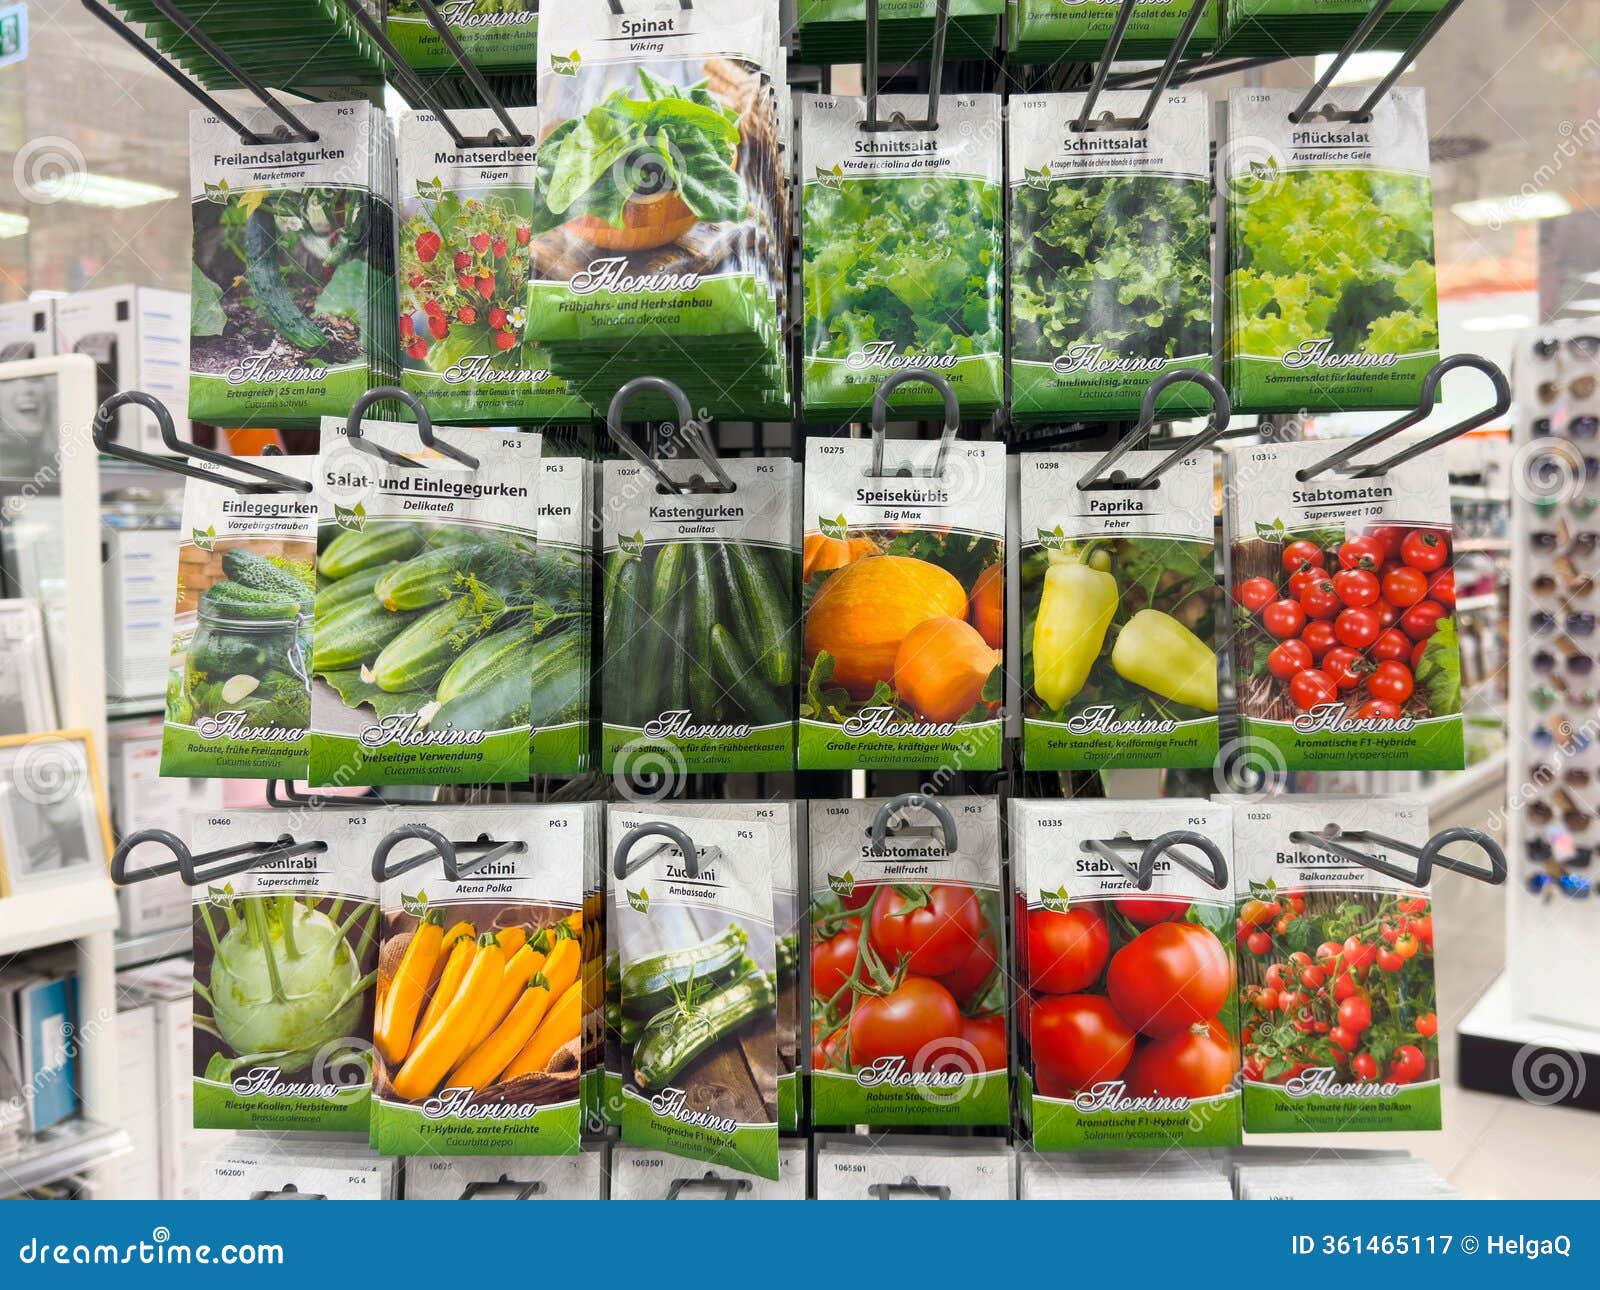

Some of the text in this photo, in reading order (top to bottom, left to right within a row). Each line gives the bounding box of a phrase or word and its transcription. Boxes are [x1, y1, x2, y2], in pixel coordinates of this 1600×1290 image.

[426, 0, 533, 30] Florina
[1069, 10, 1087, 19] und
[1088, 10, 1113, 19] letzte
[621, 18, 675, 37] Spinat
[629, 41, 665, 53] Viking
[1168, 96, 1187, 104] PG 2
[337, 108, 349, 116] PG
[1063, 136, 1149, 151] Schnittsalat
[1292, 131, 1370, 144] Pflücksalat
[854, 140, 939, 153] Schnittsalat
[213, 148, 345, 166] Freilandsalatgurken
[1292, 151, 1372, 161] Australische Gele
[843, 158, 951, 170] Verde ricciolina da taglio
[252, 170, 306, 182] Marketmore
[480, 170, 509, 181] Rügen
[568, 256, 703, 296] Florina
[558, 297, 713, 314] Frühjahrs- und Herbstanbau
[845, 340, 960, 371] Florina
[1052, 343, 1168, 375] Florina
[1281, 337, 1399, 370] Florina
[226, 355, 329, 387] Florina
[443, 354, 552, 385] Florina
[1264, 371, 1417, 384] Sommersalat für laufende Ernte
[226, 385, 326, 400] Ertragreich 25 cm lang
[502, 439, 522, 449] PG 3
[819, 446, 845, 455] 10275
[967, 449, 986, 458] PG 3
[1035, 462, 1060, 470] 10298
[1191, 458, 1198, 466] 5
[545, 465, 564, 473] PG 3
[756, 465, 775, 474] PG 5
[326, 471, 529, 498] Salat- und Einlegegurken
[856, 488, 949, 505] Speisekürbis
[1292, 485, 1393, 503] Stabtomaten
[222, 500, 319, 517] Einlegegurken
[403, 500, 455, 513] Delikateß
[649, 504, 744, 520] Kastengurken
[1090, 498, 1144, 514] Paprika
[883, 510, 922, 521] Big Max
[1303, 506, 1383, 521] Supersweet 100
[227, 520, 309, 532] Vorgebirgstrauben
[677, 525, 716, 535] Qualitas
[1103, 519, 1131, 529] Feher
[643, 709, 752, 740] Florina
[842, 706, 956, 738] Florina
[1066, 704, 1177, 736] Florina
[1292, 701, 1417, 736] Florina
[199, 709, 305, 742] Florina
[359, 712, 487, 749] Florina
[700, 743, 717, 752] den
[718, 742, 785, 752] Frühbeetkasten
[826, 741, 971, 752] Große Früchte, kräftiger Wuchs
[1047, 739, 1068, 748] Sehr
[1169, 738, 1198, 748] Frucht
[1294, 737, 1417, 748] Aromatische F1-Hybride
[187, 743, 250, 756] Robuste, frühe
[216, 756, 282, 768] Cucumis sativus
[362, 751, 484, 764] Vielseitige Verwendung
[858, 754, 939, 764] Cucurbita maxima
[1303, 750, 1409, 762] Solanum lycopersicum
[384, 765, 462, 776] Cucumis sativus
[756, 810, 775, 818] PG 5
[825, 807, 850, 815] 10340
[964, 806, 983, 814] PG 3
[207, 817, 231, 826] 10460
[348, 817, 367, 825] PG 3
[549, 820, 568, 828] PG 3
[1037, 819, 1063, 828] 10335
[1188, 817, 1207, 826] PG 5
[737, 830, 754, 839] PG 5
[883, 865, 929, 875] Hellfrucht
[257, 877, 320, 887] Superschmelz
[1299, 872, 1365, 882] Balkonzauber
[455, 883, 513, 893] Atena Polka
[668, 885, 717, 899] Ambassador
[856, 1055, 968, 1088] Florina
[233, 1066, 340, 1098] Florina
[1284, 1066, 1399, 1098] Florina
[866, 1092, 903, 1102] Robuste
[1074, 1079, 1191, 1114] Florina
[224, 1101, 349, 1113] Riesige Knollen, Herbsternte
[422, 1086, 538, 1120] Florina
[1306, 1102, 1412, 1112] Tomate Balkon
[650, 1086, 738, 1135] Florina
[650, 1119, 695, 1139] Ertragreiche
[1075, 1118, 1136, 1128] Aromatische
[419, 1124, 540, 1136] F1-Hybride, zarte Früchte
[489, 1137, 514, 1148] pepo
[214, 1168, 246, 1178] 1062001
[348, 1176, 367, 1185] PG 4
